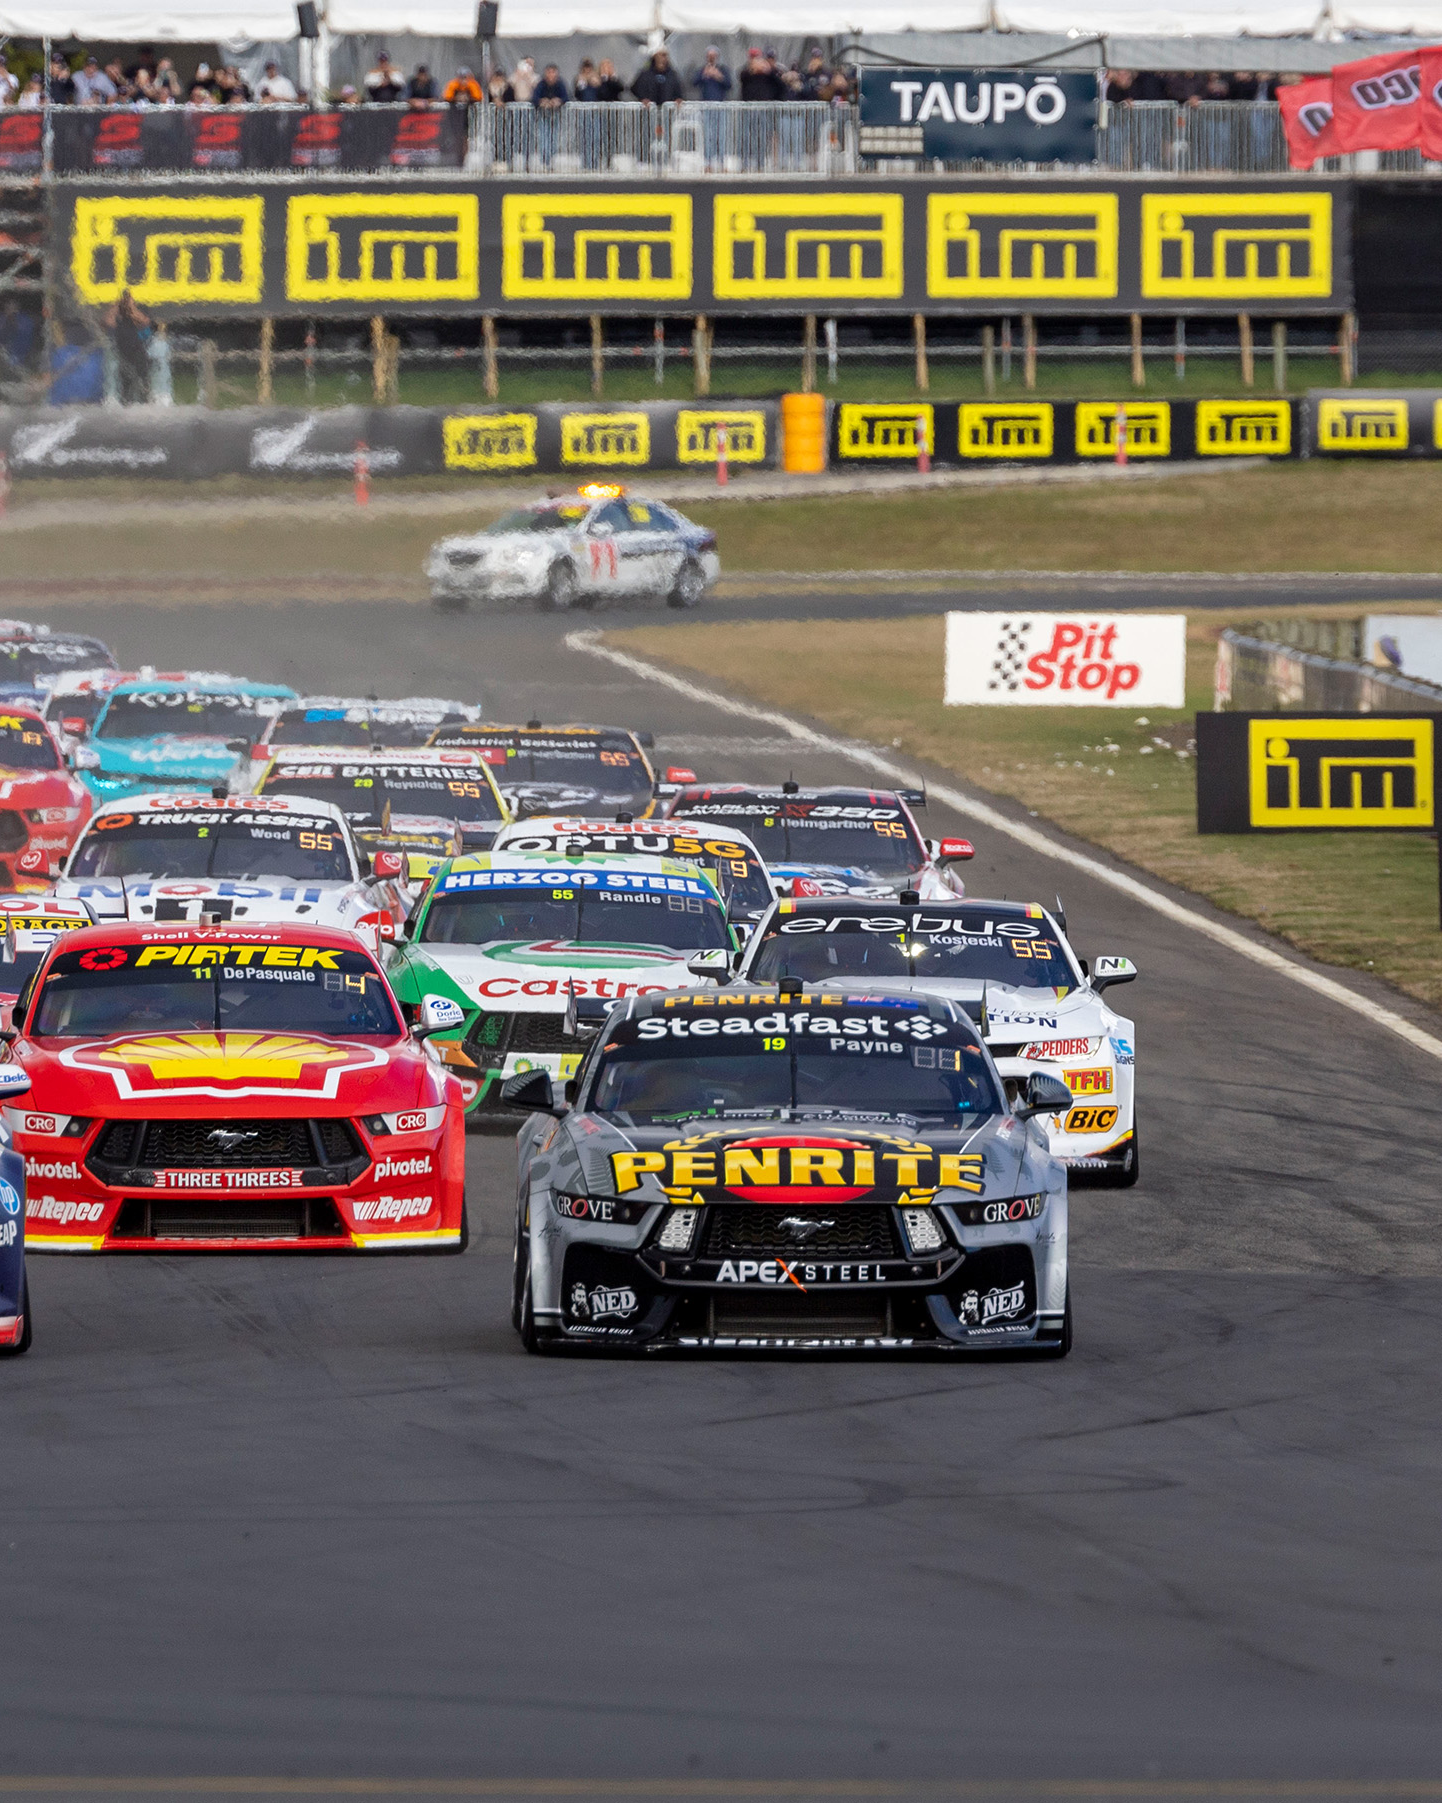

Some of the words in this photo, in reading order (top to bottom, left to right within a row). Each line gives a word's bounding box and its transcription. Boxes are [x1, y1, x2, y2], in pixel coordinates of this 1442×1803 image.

[890, 76, 1066, 124] TAUPŌ
[1046, 622, 1119, 662] Pit
[1024, 652, 1142, 700] Stop
[149, 796, 289, 811] Coates
[138, 812, 232, 827] TRUCK
[236, 813, 333, 830] ASSIST
[553, 821, 699, 835] Coates
[197, 827, 209, 838] 2
[250, 828, 292, 841] Wood
[299, 832, 334, 852] 55
[77, 881, 323, 903] Mobil
[445, 869, 599, 890] HERZOG
[607, 871, 706, 895] STEEL
[552, 889, 574, 900] 55
[599, 890, 661, 905] Randle
[141, 932, 188, 941] Shell
[194, 932, 281, 942] V-Power
[780, 913, 1040, 939] erebus
[896, 933, 905, 943] 1
[929, 933, 1003, 948] Kostecki
[1011, 938, 1052, 960] 55
[135, 945, 345, 970] PIRTEK
[192, 968, 212, 980] 11
[345, 973, 365, 995] 4
[664, 993, 844, 1007] PENRITE
[436, 1010, 460, 1018] Doric
[637, 1012, 889, 1040] Steadfast
[762, 1038, 786, 1051] 19
[830, 1038, 903, 1054] Payne
[1042, 1037, 1089, 1056] PEDDERS
[1067, 1069, 1107, 1090] TFH
[26, 1117, 55, 1132] CRC
[397, 1113, 426, 1128] CRC
[168, 1172, 222, 1187] THREE
[226, 1171, 290, 1187] THREES
[374, 1155, 433, 1182] pivotel.
[611, 1147, 985, 1194] PENRITE
[38, 1196, 105, 1224] Repco
[374, 1196, 433, 1222] Repco
[557, 1197, 614, 1221] GROVE
[983, 1194, 1040, 1223] GROVE
[716, 1259, 803, 1288] APEX
[805, 1265, 887, 1281] STEEL
[591, 1290, 637, 1314] NED
[982, 1289, 1025, 1314] NED
